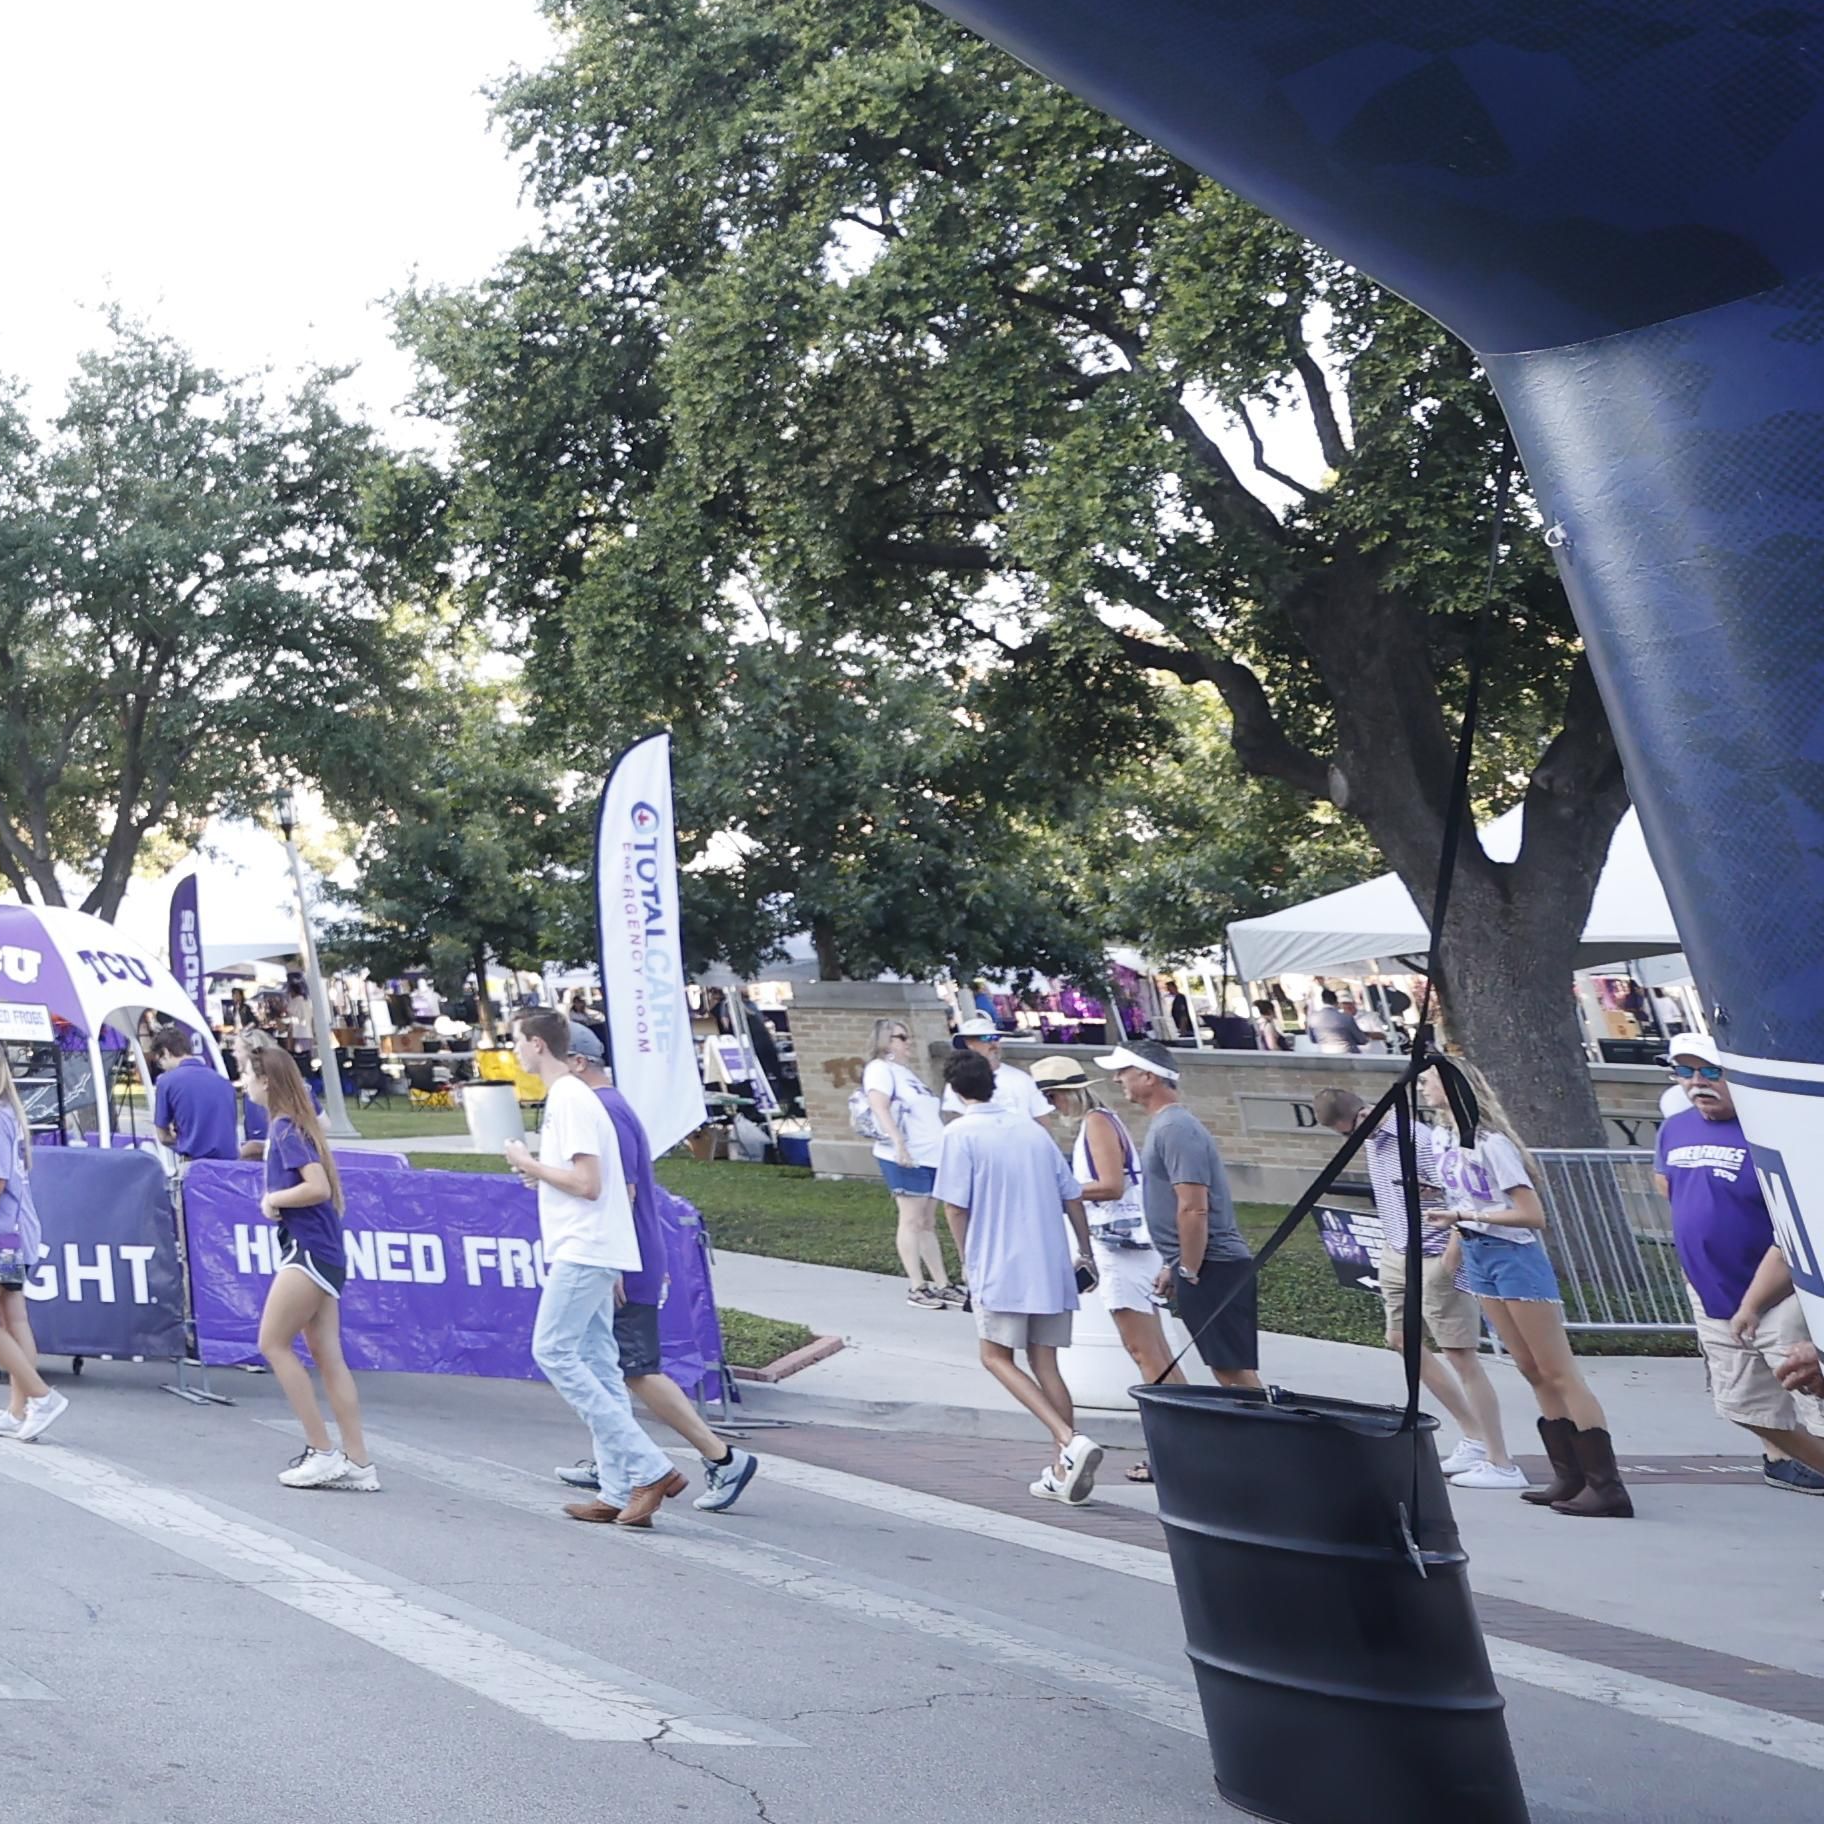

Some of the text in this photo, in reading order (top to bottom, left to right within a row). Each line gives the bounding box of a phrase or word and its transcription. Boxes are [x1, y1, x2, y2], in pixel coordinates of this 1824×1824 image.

[77, 950, 154, 987] TCU
[623, 842, 651, 1054] EMERGENCY ROOM
[234, 1223, 447, 1284] HNED
